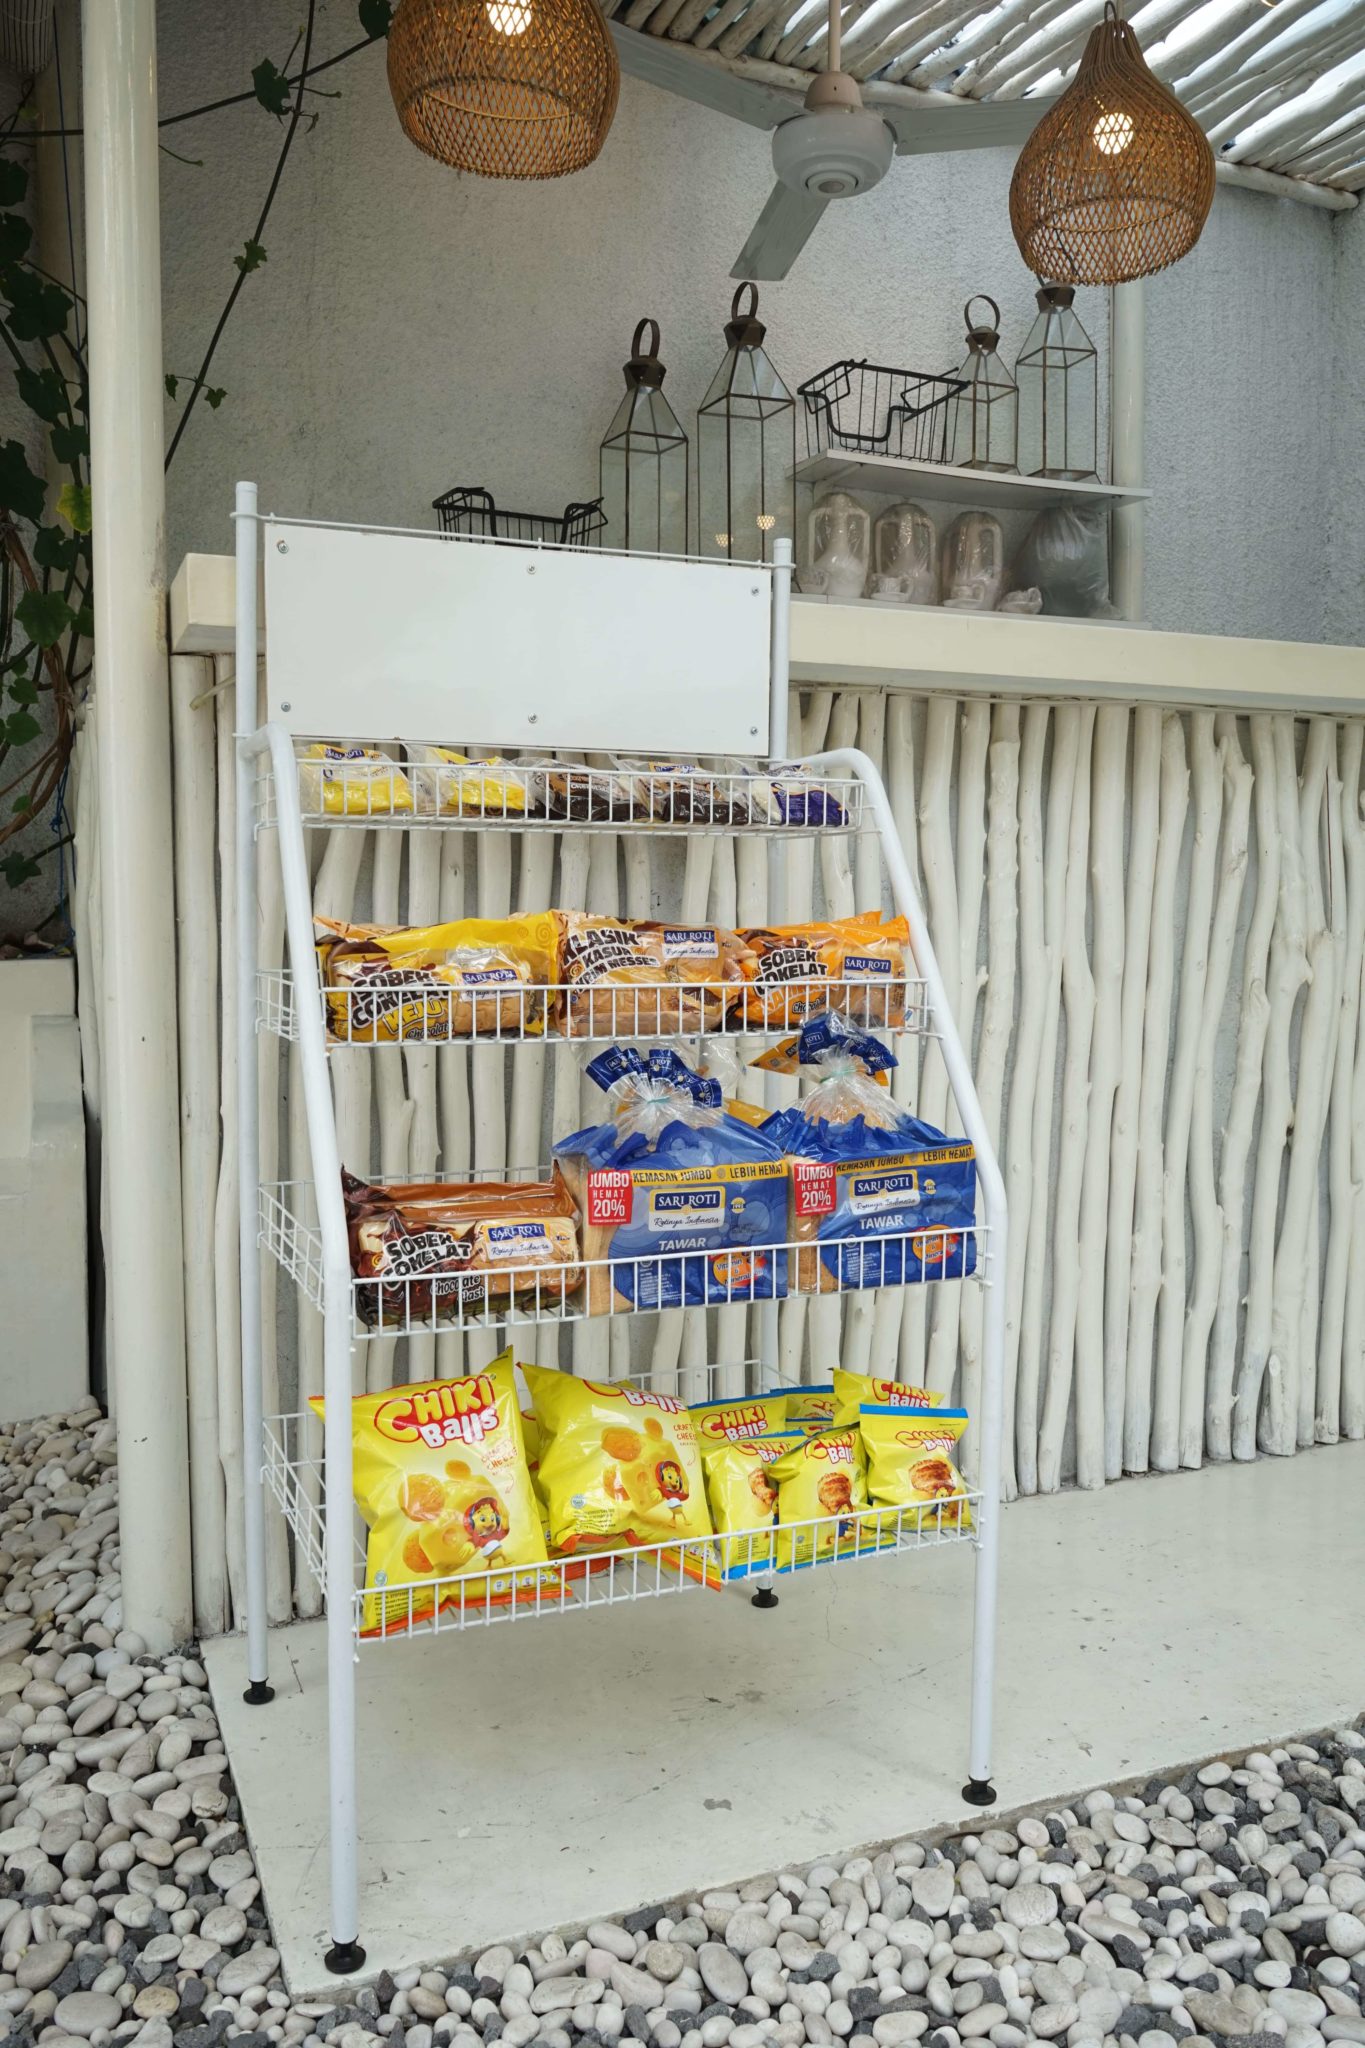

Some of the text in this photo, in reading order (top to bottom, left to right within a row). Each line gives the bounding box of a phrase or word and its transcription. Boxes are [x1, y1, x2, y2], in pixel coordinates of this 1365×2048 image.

[564, 929, 640, 964] KLASIK
[666, 931, 712, 942] SARI ROTI
[583, 947, 632, 968] KASUR
[760, 950, 817, 973] SOBEK
[845, 958, 890, 970] SARI ROTI
[353, 969, 431, 1002] SOBEK
[465, 974, 488, 982] SARI
[754, 963, 828, 995] COKELAT
[384, 1000, 443, 1034] KEJU
[837, 1146, 973, 1172] KEMASAN JUMBO LEBIH HEMAT
[589, 1172, 630, 1188] JUMBO
[633, 1162, 784, 1183] KEMASAN JUMBO LEBIH HEMAT
[797, 1166, 834, 1181] JUMBO
[593, 1190, 625, 1199] HEMAT
[801, 1180, 830, 1191] HEMAT
[857, 1177, 910, 1193] SARI ROTI
[593, 1199, 625, 1217] 20%
[658, 1194, 717, 1206] SARI ROTI
[802, 1190, 832, 1209] 20%
[491, 1225, 543, 1240] SARI ROTI
[859, 1215, 905, 1230] TAWAR
[386, 1232, 453, 1264] SOBEK
[659, 1238, 706, 1251] TAWAR
[382, 1243, 471, 1289] COKELAT
[872, 1377, 931, 1402] CHIKI
[374, 1375, 495, 1443] CHIKI
[622, 1388, 688, 1414] Balls
[889, 1393, 930, 1409] Balls
[420, 1407, 500, 1449] Balls
[701, 1404, 766, 1440] CHIKI
[725, 1419, 769, 1442] Balls
